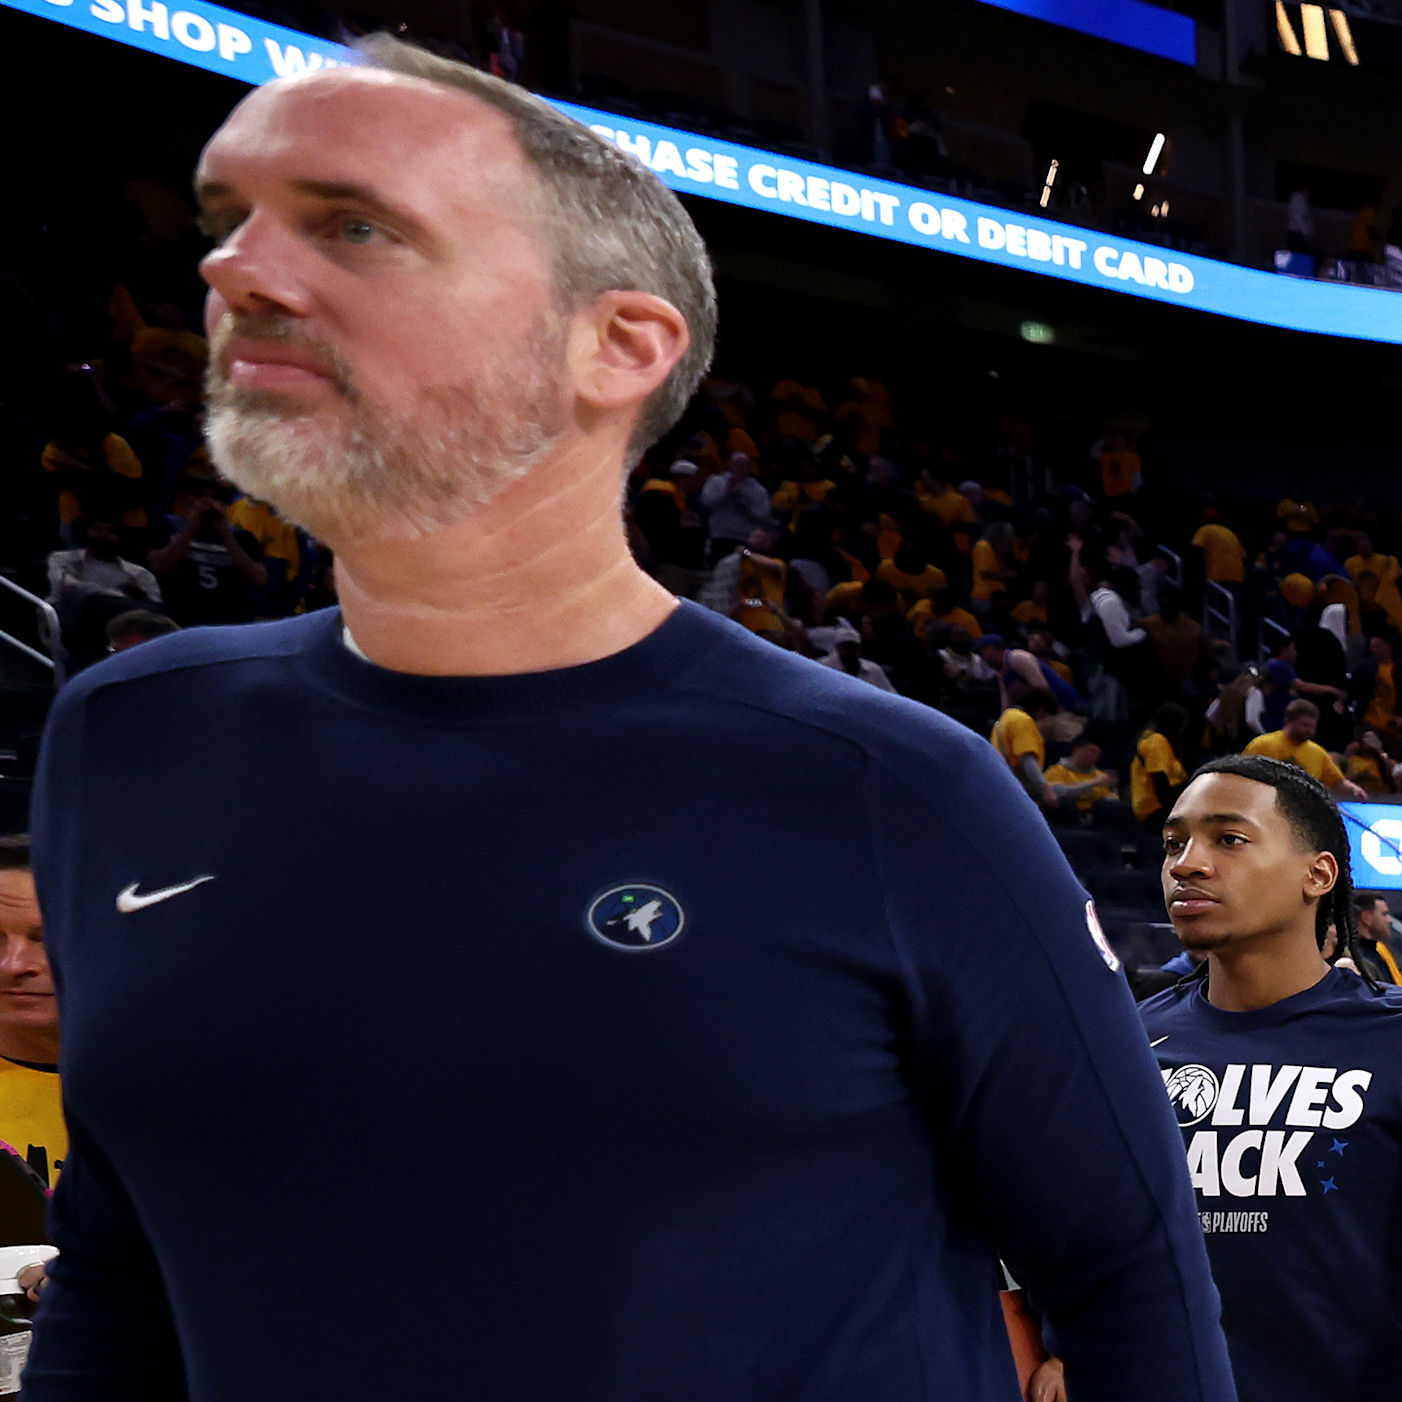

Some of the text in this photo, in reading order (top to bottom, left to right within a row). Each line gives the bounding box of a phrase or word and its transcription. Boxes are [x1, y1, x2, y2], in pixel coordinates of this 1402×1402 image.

[90, 0, 252, 61] SHOP
[748, 164, 900, 226] CREDIT
[908, 202, 970, 244] OR
[977, 217, 1087, 269] DEBIT
[1094, 246, 1194, 293] CARD
[1158, 1064, 1373, 1130] OLVES
[1186, 1130, 1315, 1197] ACK
[1212, 1211, 1268, 1234] PLAYOFFS
